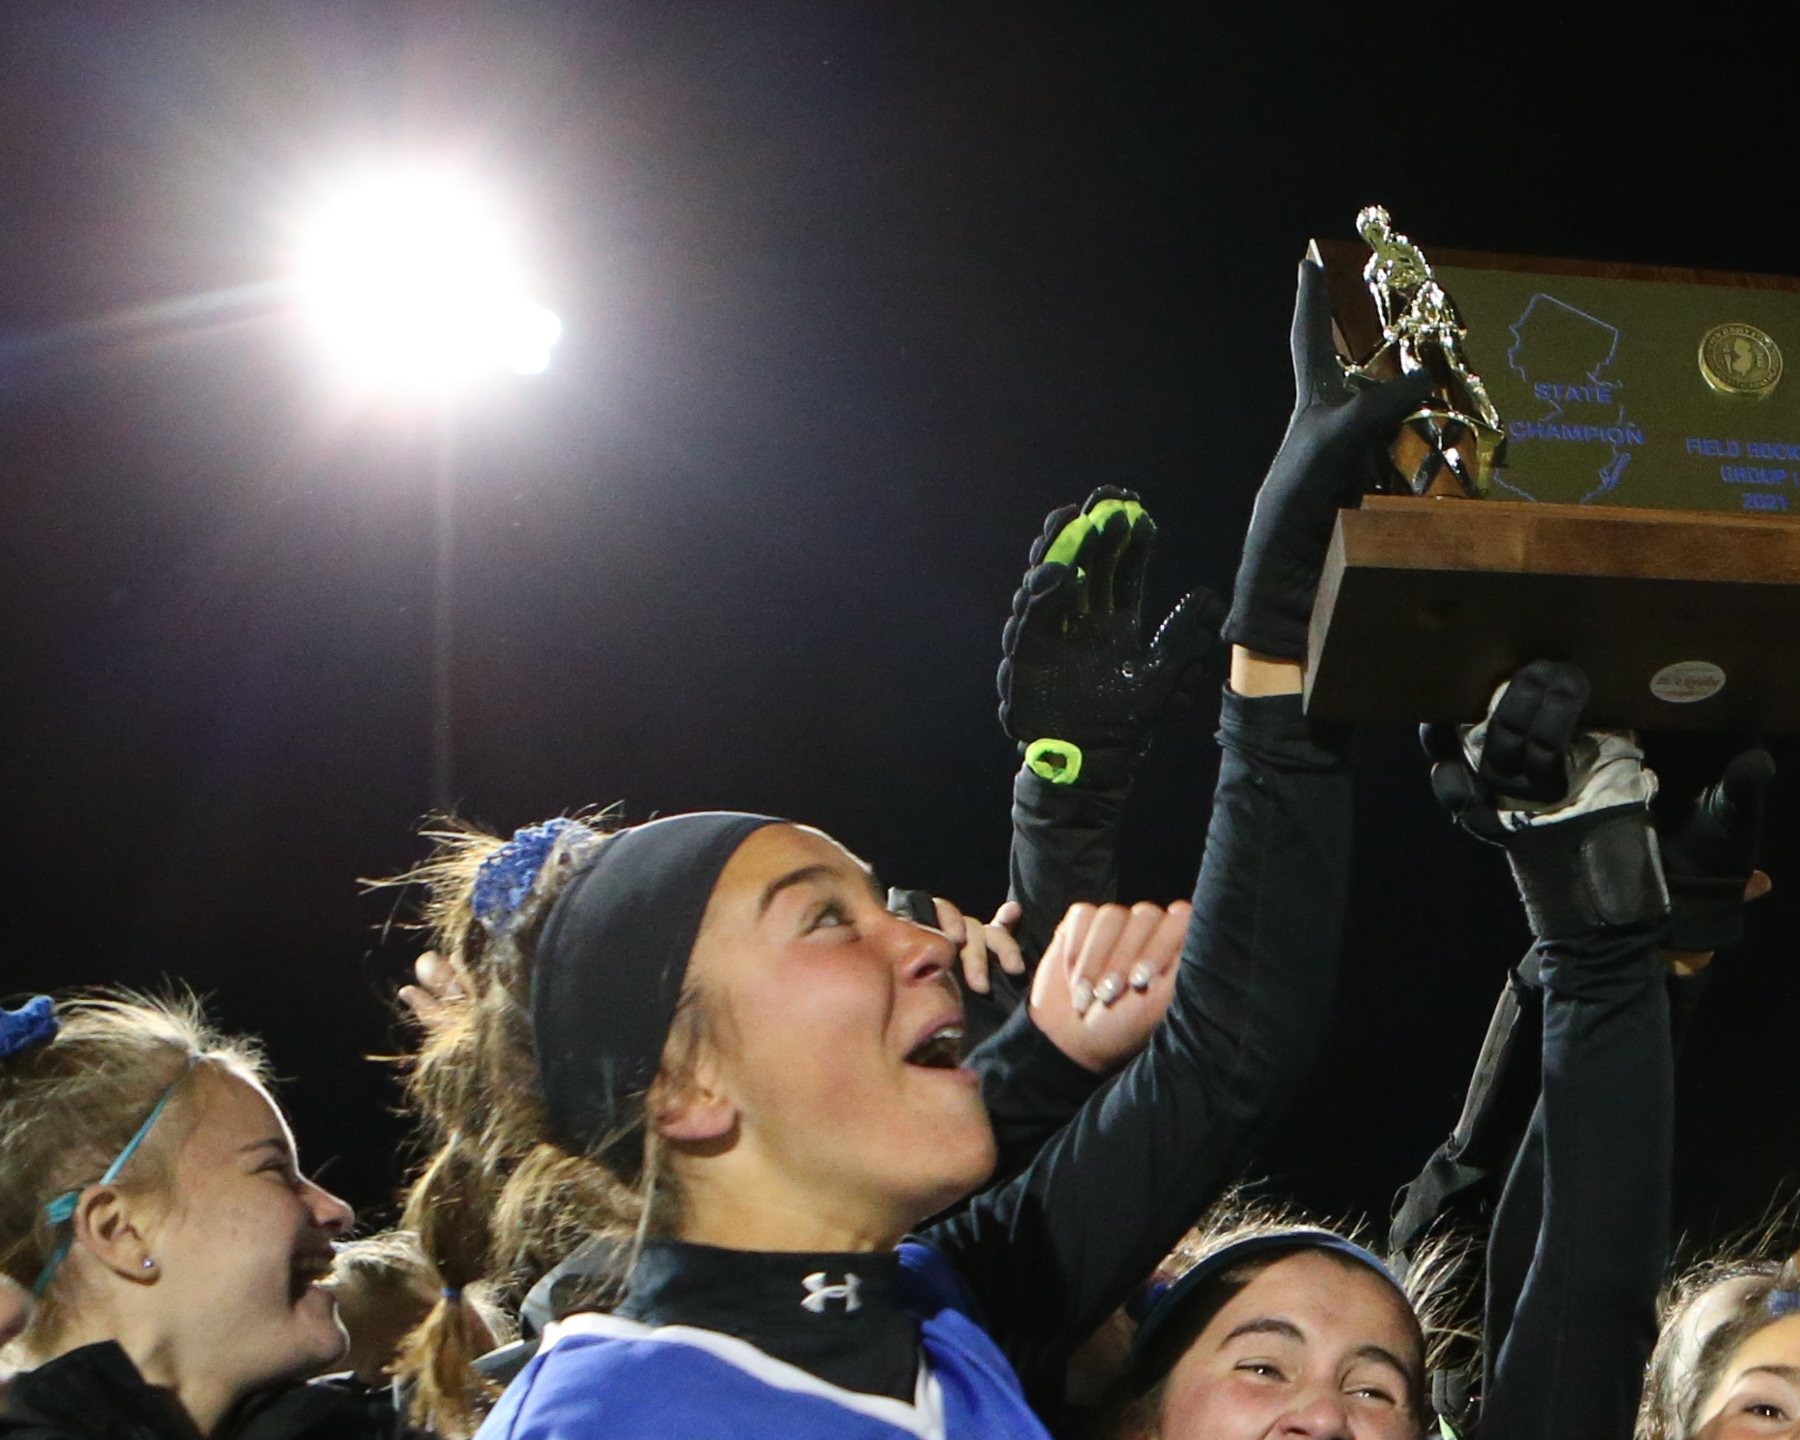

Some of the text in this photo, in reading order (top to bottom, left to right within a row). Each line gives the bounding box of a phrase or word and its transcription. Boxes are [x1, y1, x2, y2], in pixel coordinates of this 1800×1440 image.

[1534, 382, 1613, 404] STATE
[1509, 421, 1645, 445] CHAMPION
[1686, 437, 1742, 458] FIELD
[1721, 465, 1788, 484] GROUP
[1742, 492, 1788, 511] 2021
